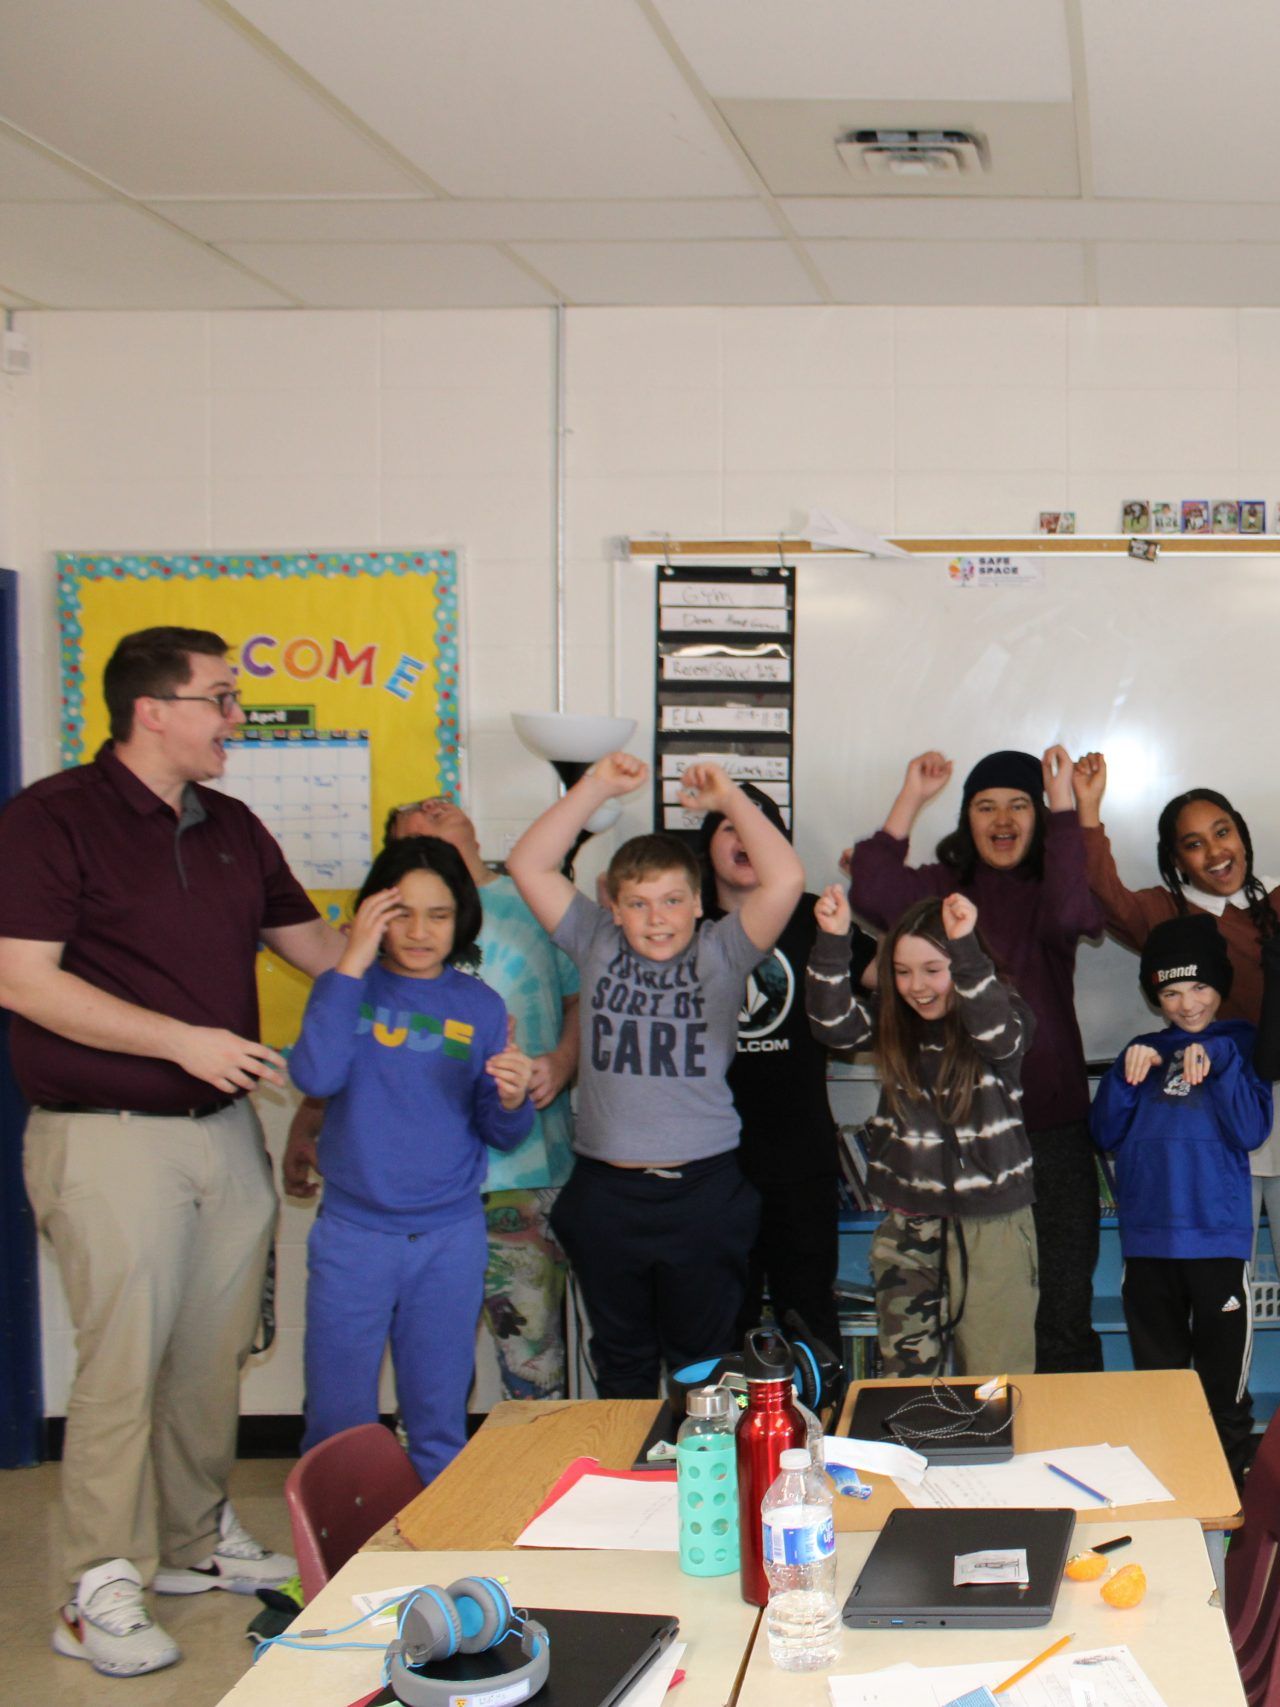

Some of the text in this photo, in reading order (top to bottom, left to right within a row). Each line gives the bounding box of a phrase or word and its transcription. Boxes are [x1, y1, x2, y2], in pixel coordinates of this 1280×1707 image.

[978, 557, 1011, 566] SAFE
[978, 567, 1019, 575] SPACE
[230, 635, 428, 702] COME
[1157, 964, 1198, 983] Brandt
[591, 976, 706, 1019] SORT OF
[591, 1014, 708, 1078] CARE
[737, 1038, 790, 1053] LCOM
